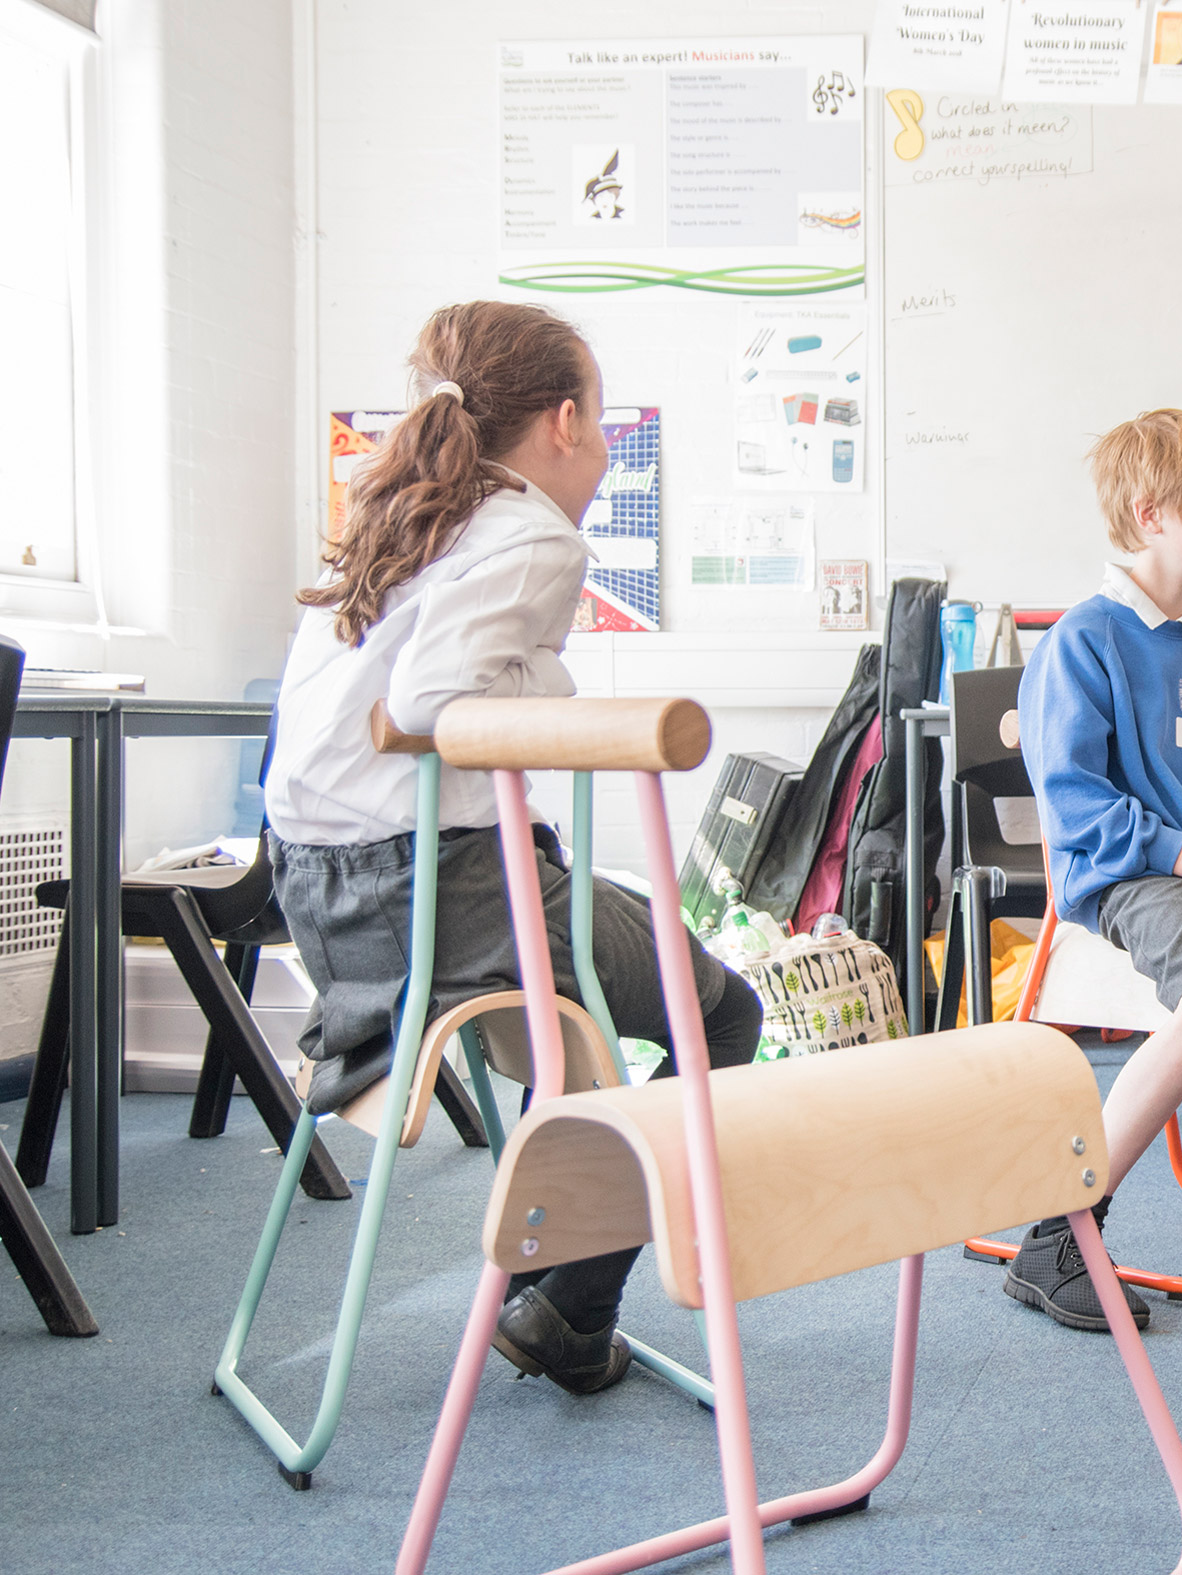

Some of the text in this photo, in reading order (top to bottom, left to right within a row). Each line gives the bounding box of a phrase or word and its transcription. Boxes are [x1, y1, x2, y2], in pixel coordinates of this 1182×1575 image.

[902, 4, 985, 20] International
[1031, 12, 1126, 32] Revolutionary
[896, 26, 985, 46] Women's Day
[1024, 36, 1128, 50] women in music
[567, 51, 593, 64] Talk
[597, 51, 619, 64] like
[622, 54, 638, 63] an
[642, 50, 687, 65] expert!
[691, 49, 755, 61] Musicians
[937, 95, 995, 119] Circled
[1000, 101, 1019, 113] in
[931, 125, 962, 141] what
[967, 125, 994, 137] does
[1001, 118, 1013, 136] it
[912, 161, 976, 184] correct
[901, 288, 957, 312] Merits
[807, 989, 854, 1005] Waitrose
